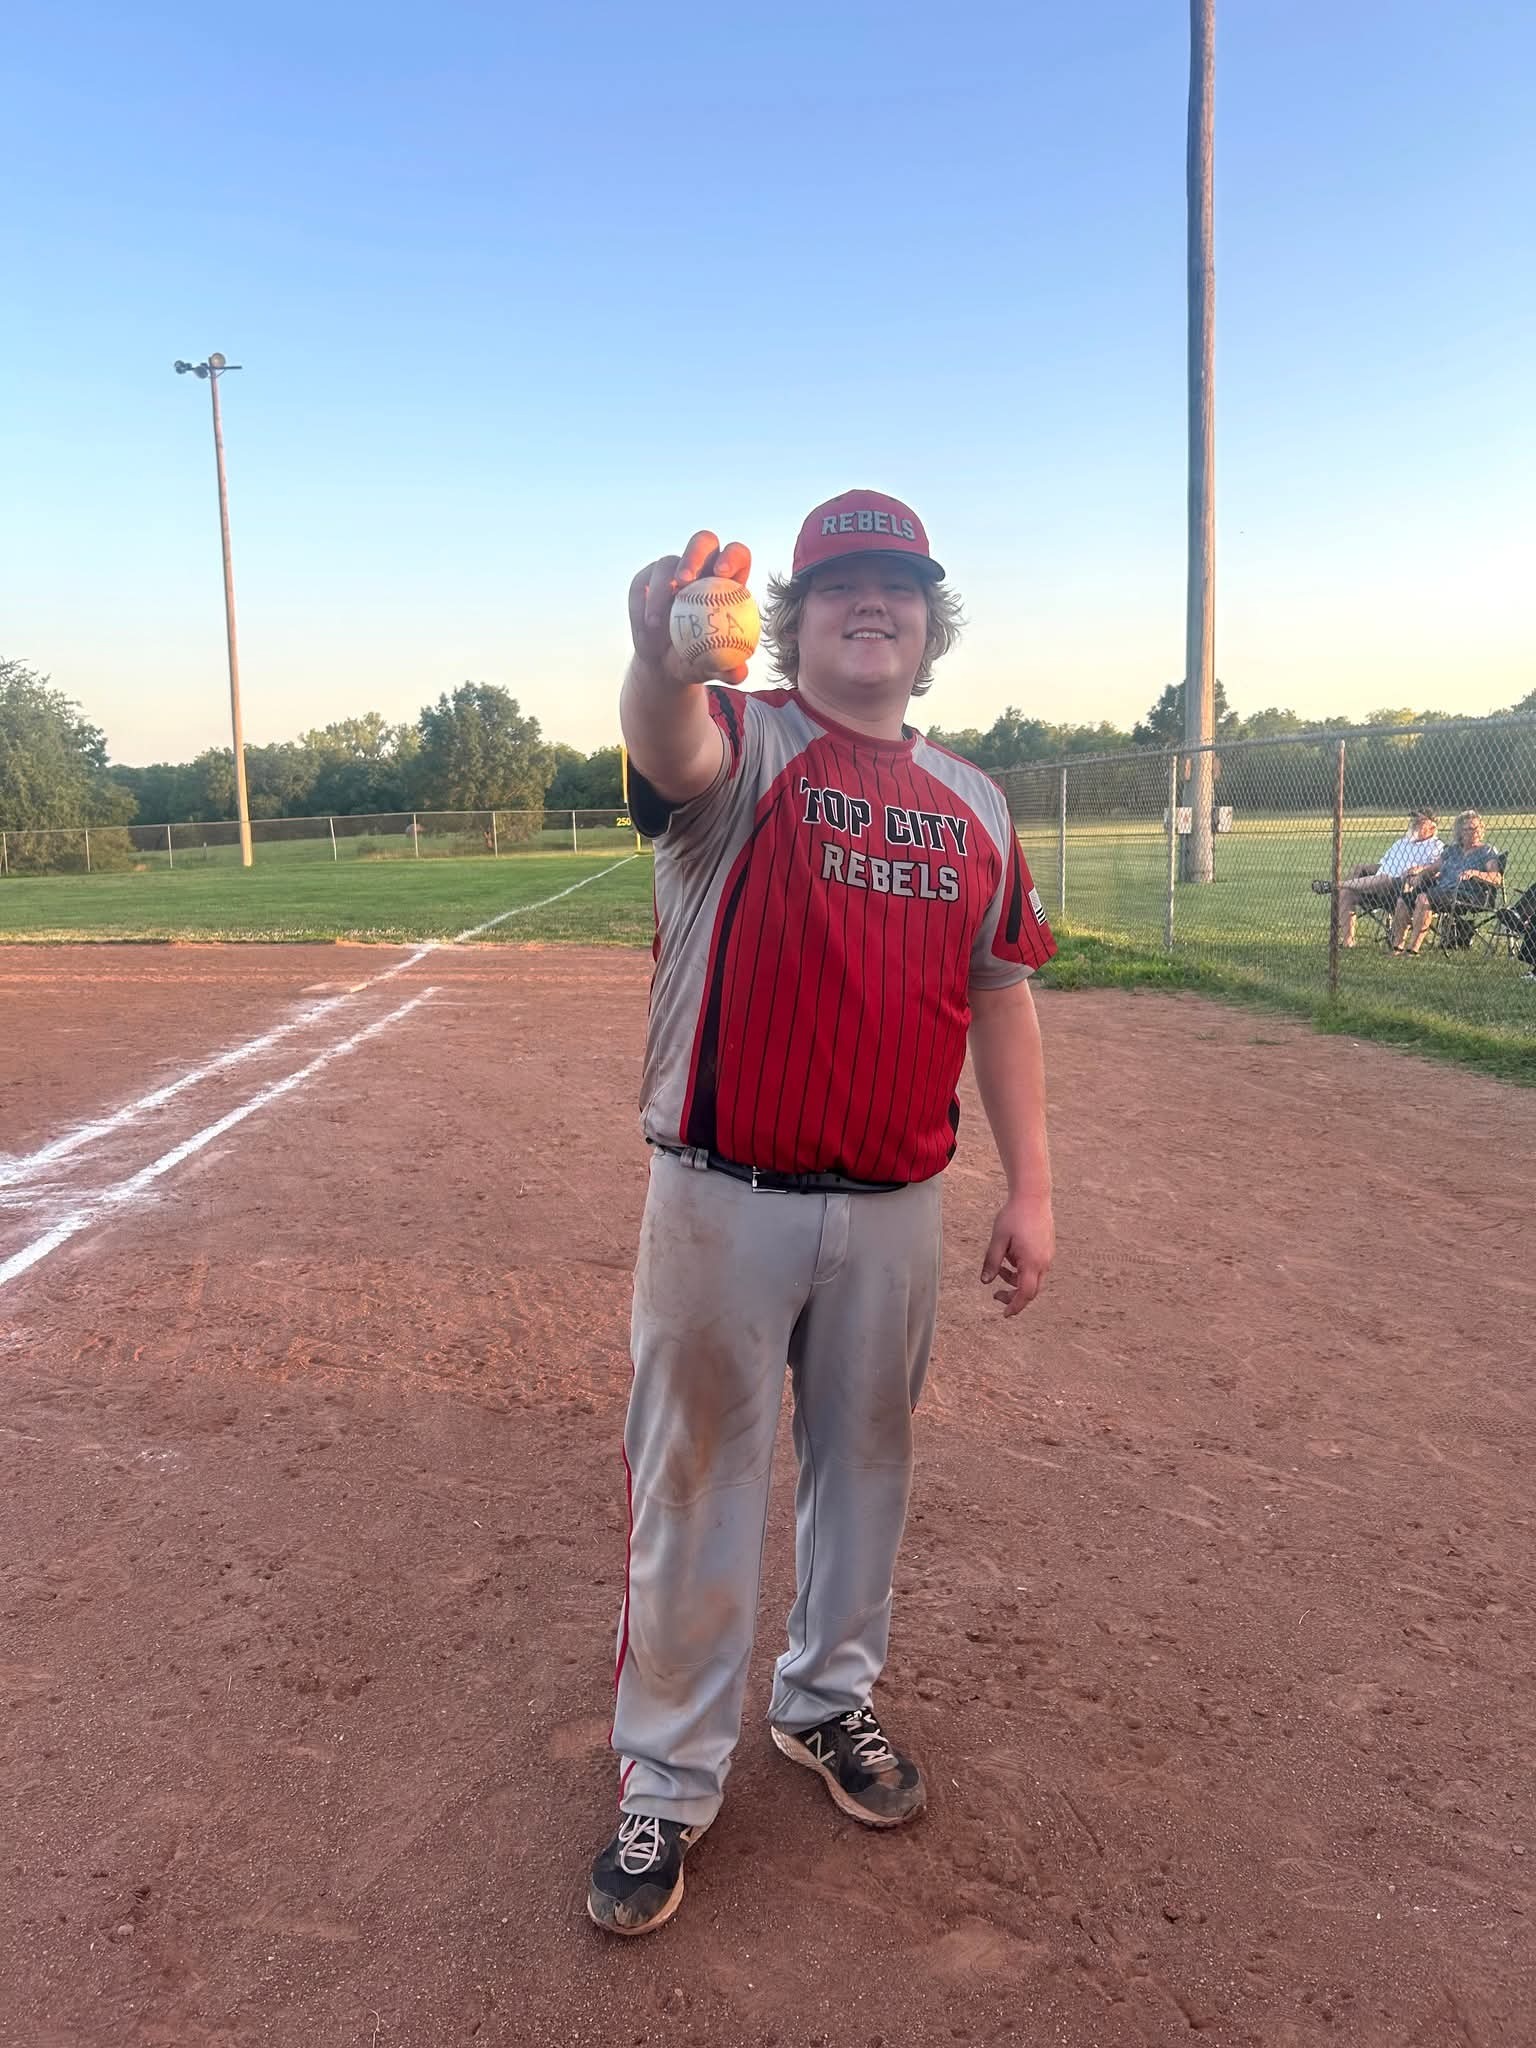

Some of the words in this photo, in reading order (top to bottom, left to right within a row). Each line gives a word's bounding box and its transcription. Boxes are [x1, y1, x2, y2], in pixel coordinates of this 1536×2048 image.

[821, 510, 916, 542] REBELS
[616, 816, 632, 827] 250
[800, 777, 871, 837] TOP
[884, 804, 968, 856] CITY
[820, 841, 960, 902] REBELS
